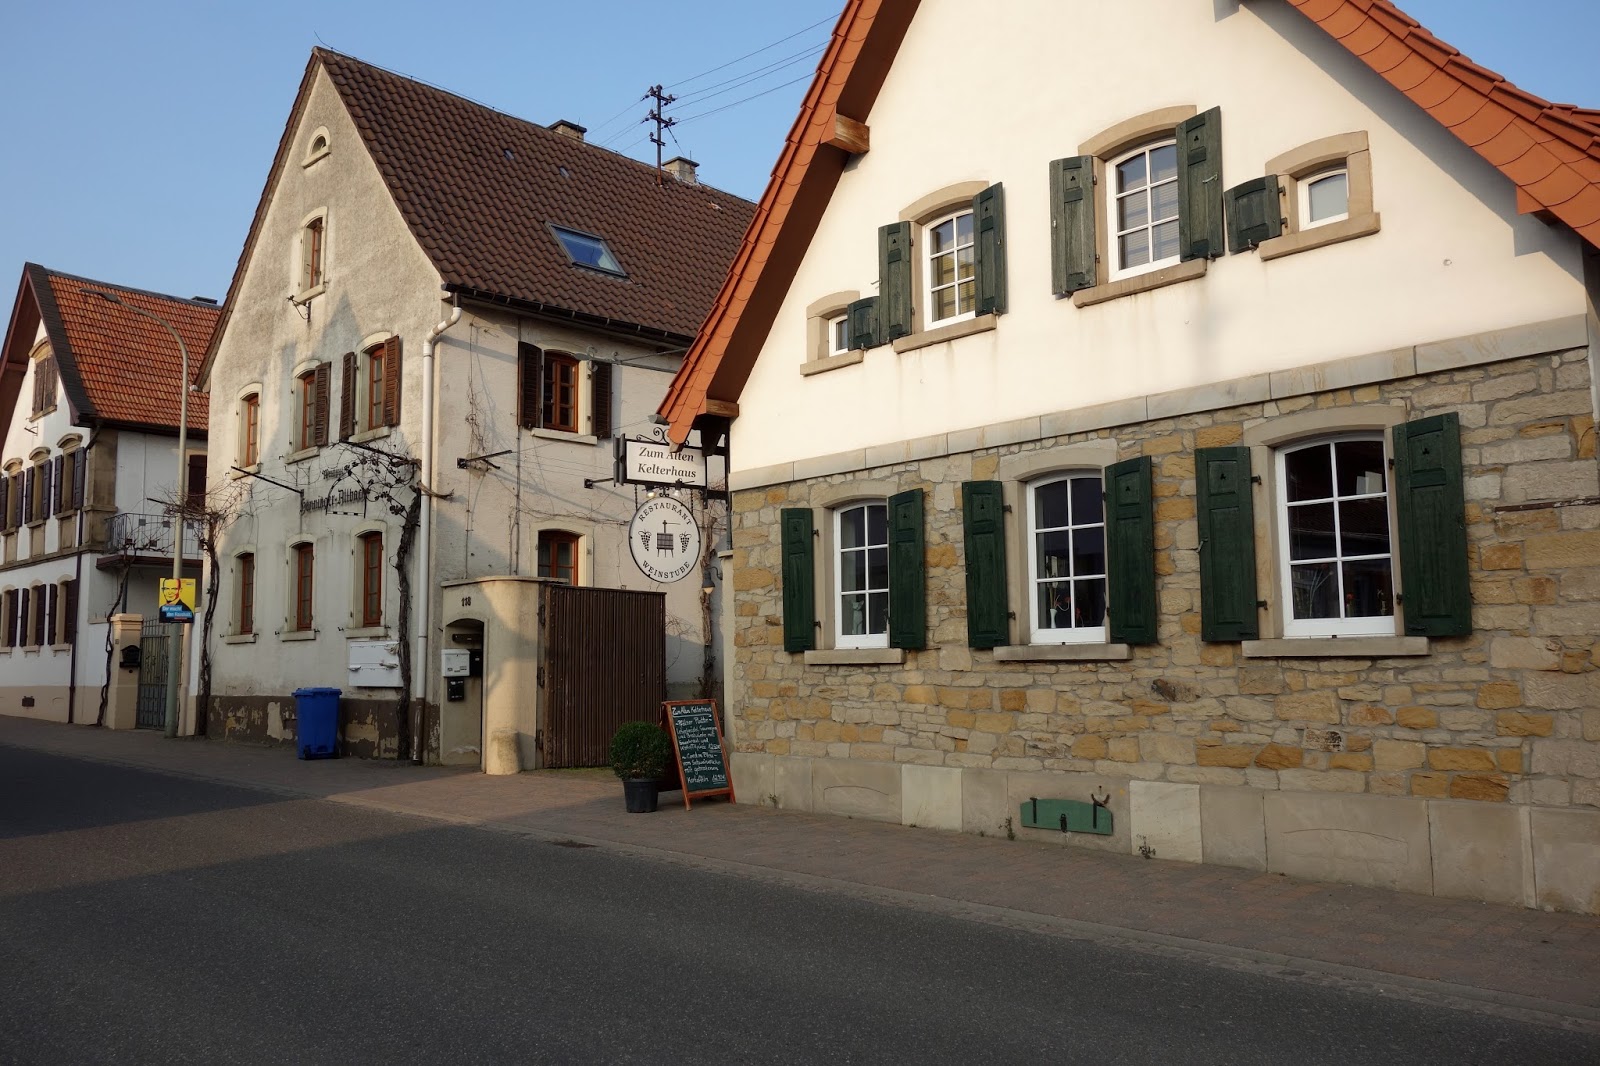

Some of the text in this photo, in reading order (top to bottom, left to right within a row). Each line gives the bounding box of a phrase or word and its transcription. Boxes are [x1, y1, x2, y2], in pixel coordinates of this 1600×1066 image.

[638, 447, 694, 462] Zum Alten
[637, 463, 697, 478] Kelterhaus
[638, 502, 693, 526] RESTAURANT
[642, 561, 690, 579] WEINSTUBE
